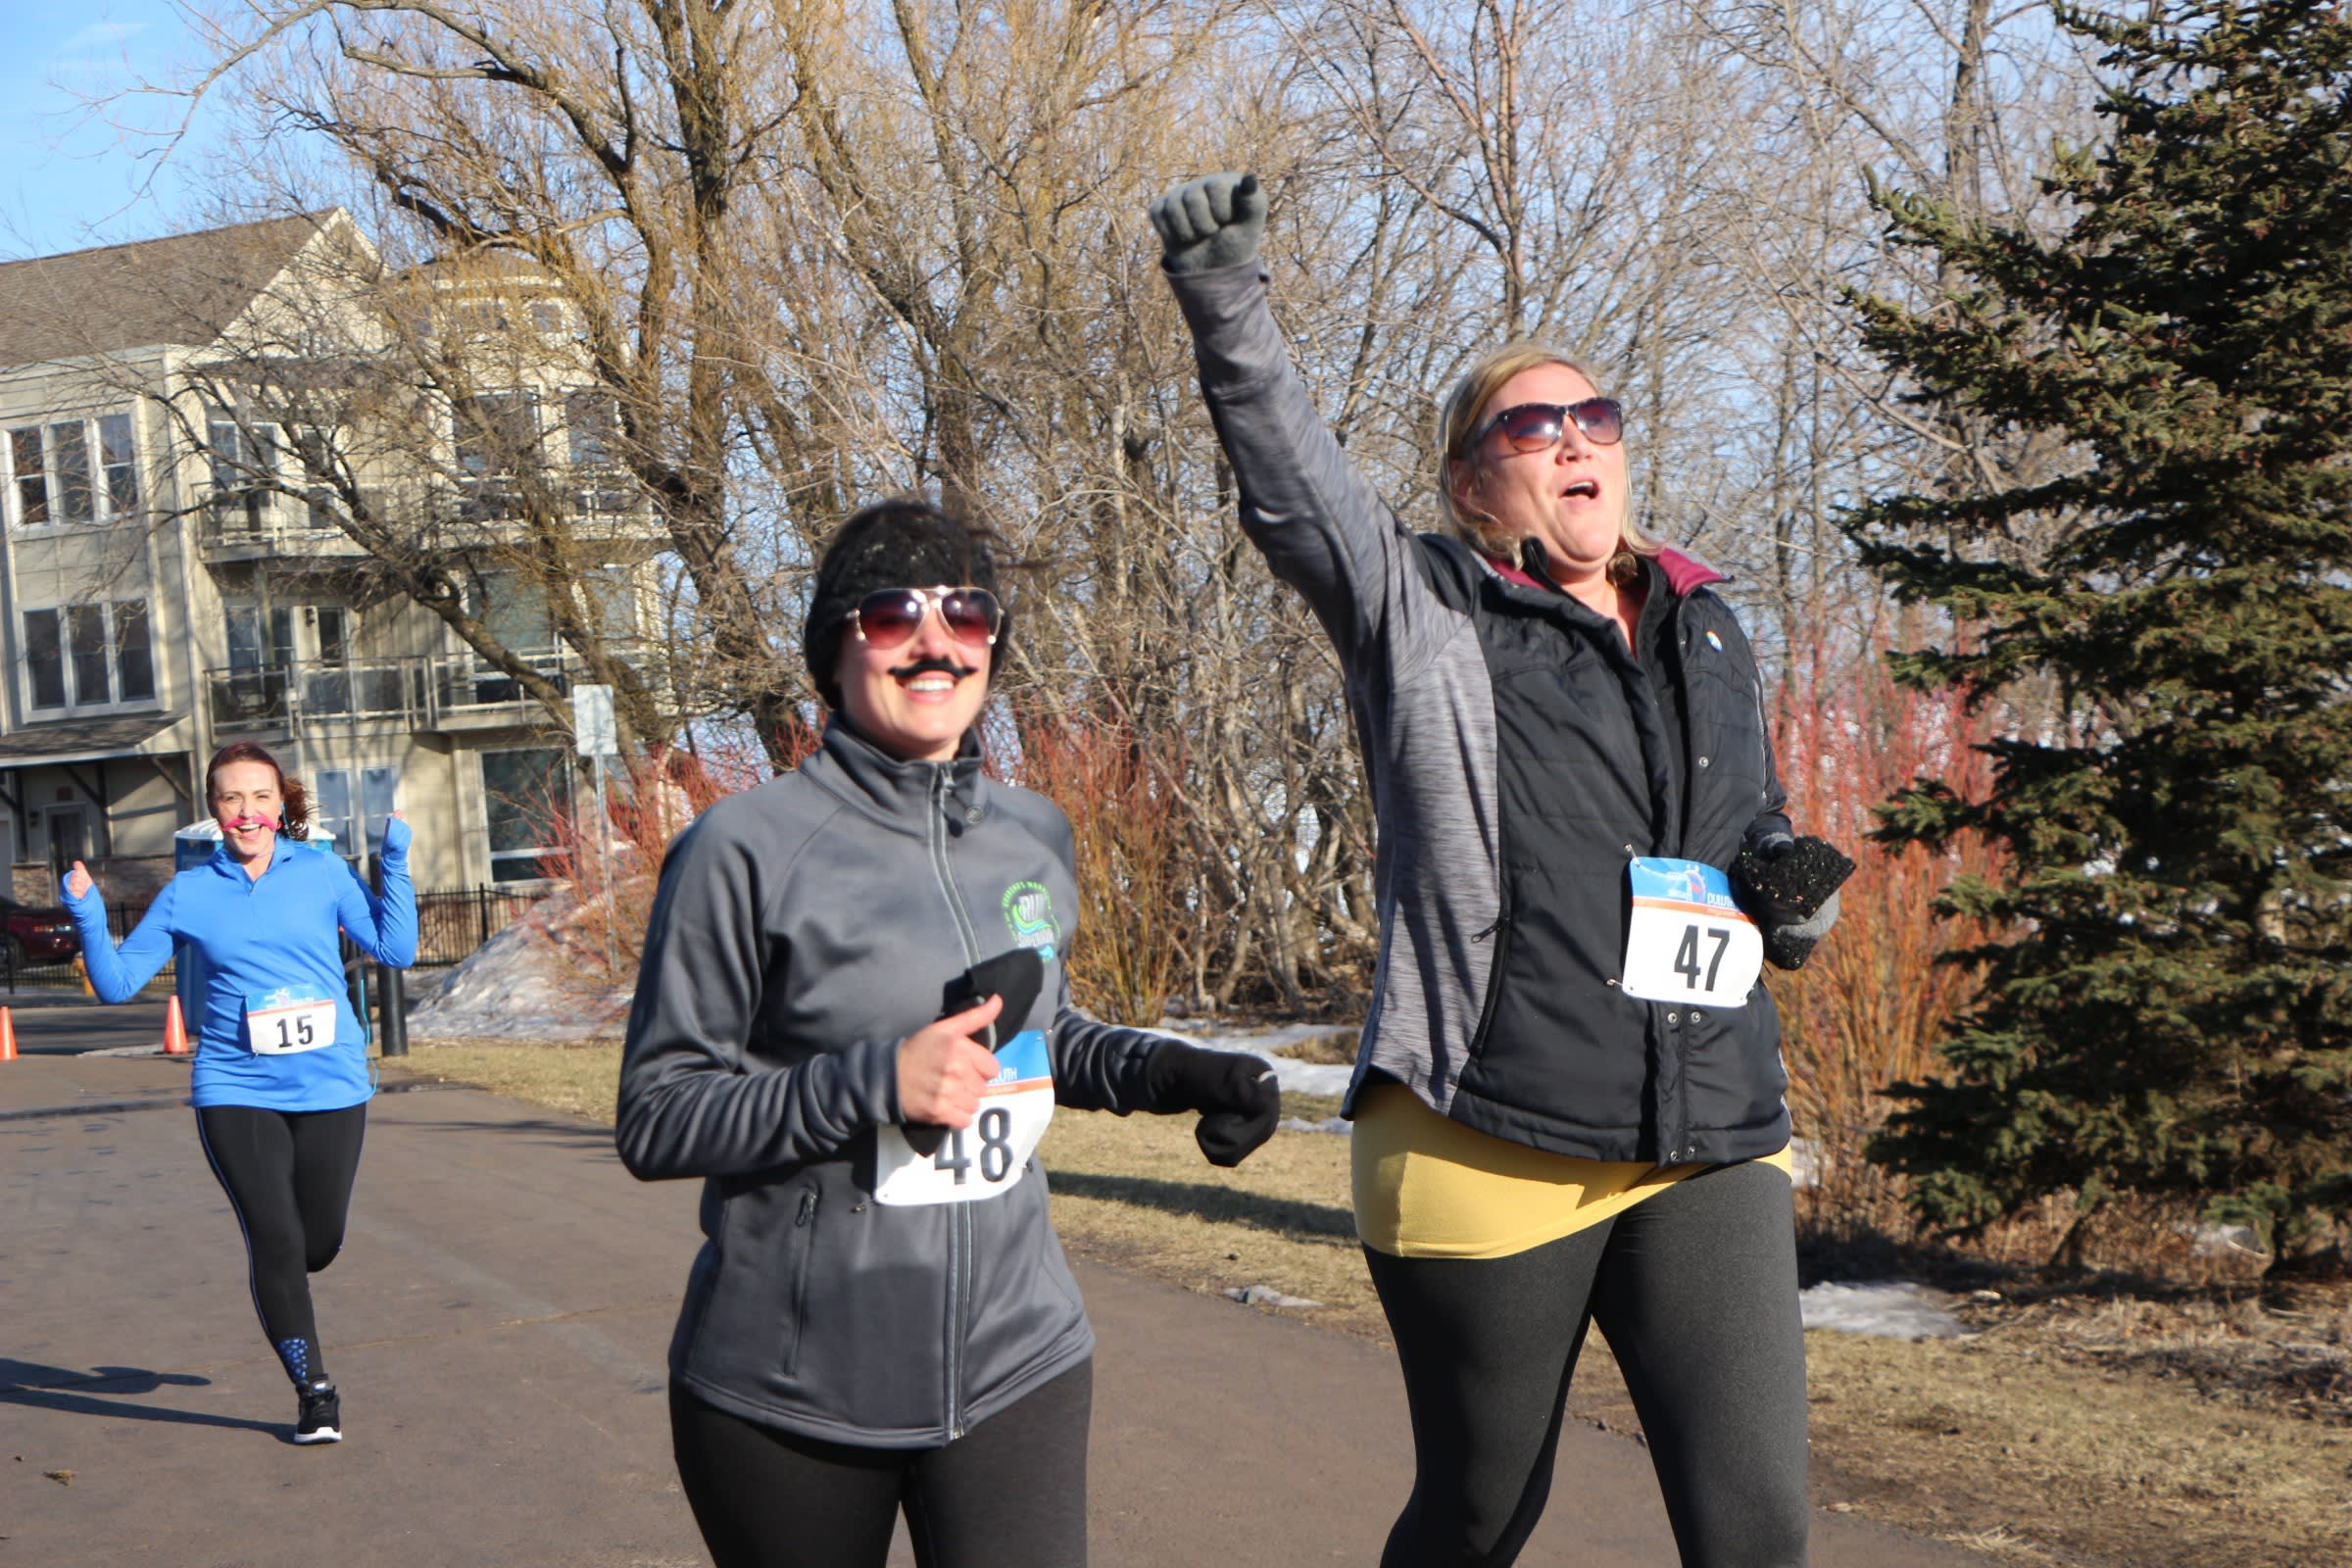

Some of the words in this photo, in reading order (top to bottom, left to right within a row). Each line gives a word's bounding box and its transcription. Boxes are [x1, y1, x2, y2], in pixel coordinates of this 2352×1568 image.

[1674, 925, 1730, 992] 47
[276, 1014, 314, 1048] 15
[934, 1106, 1014, 1185] 48
